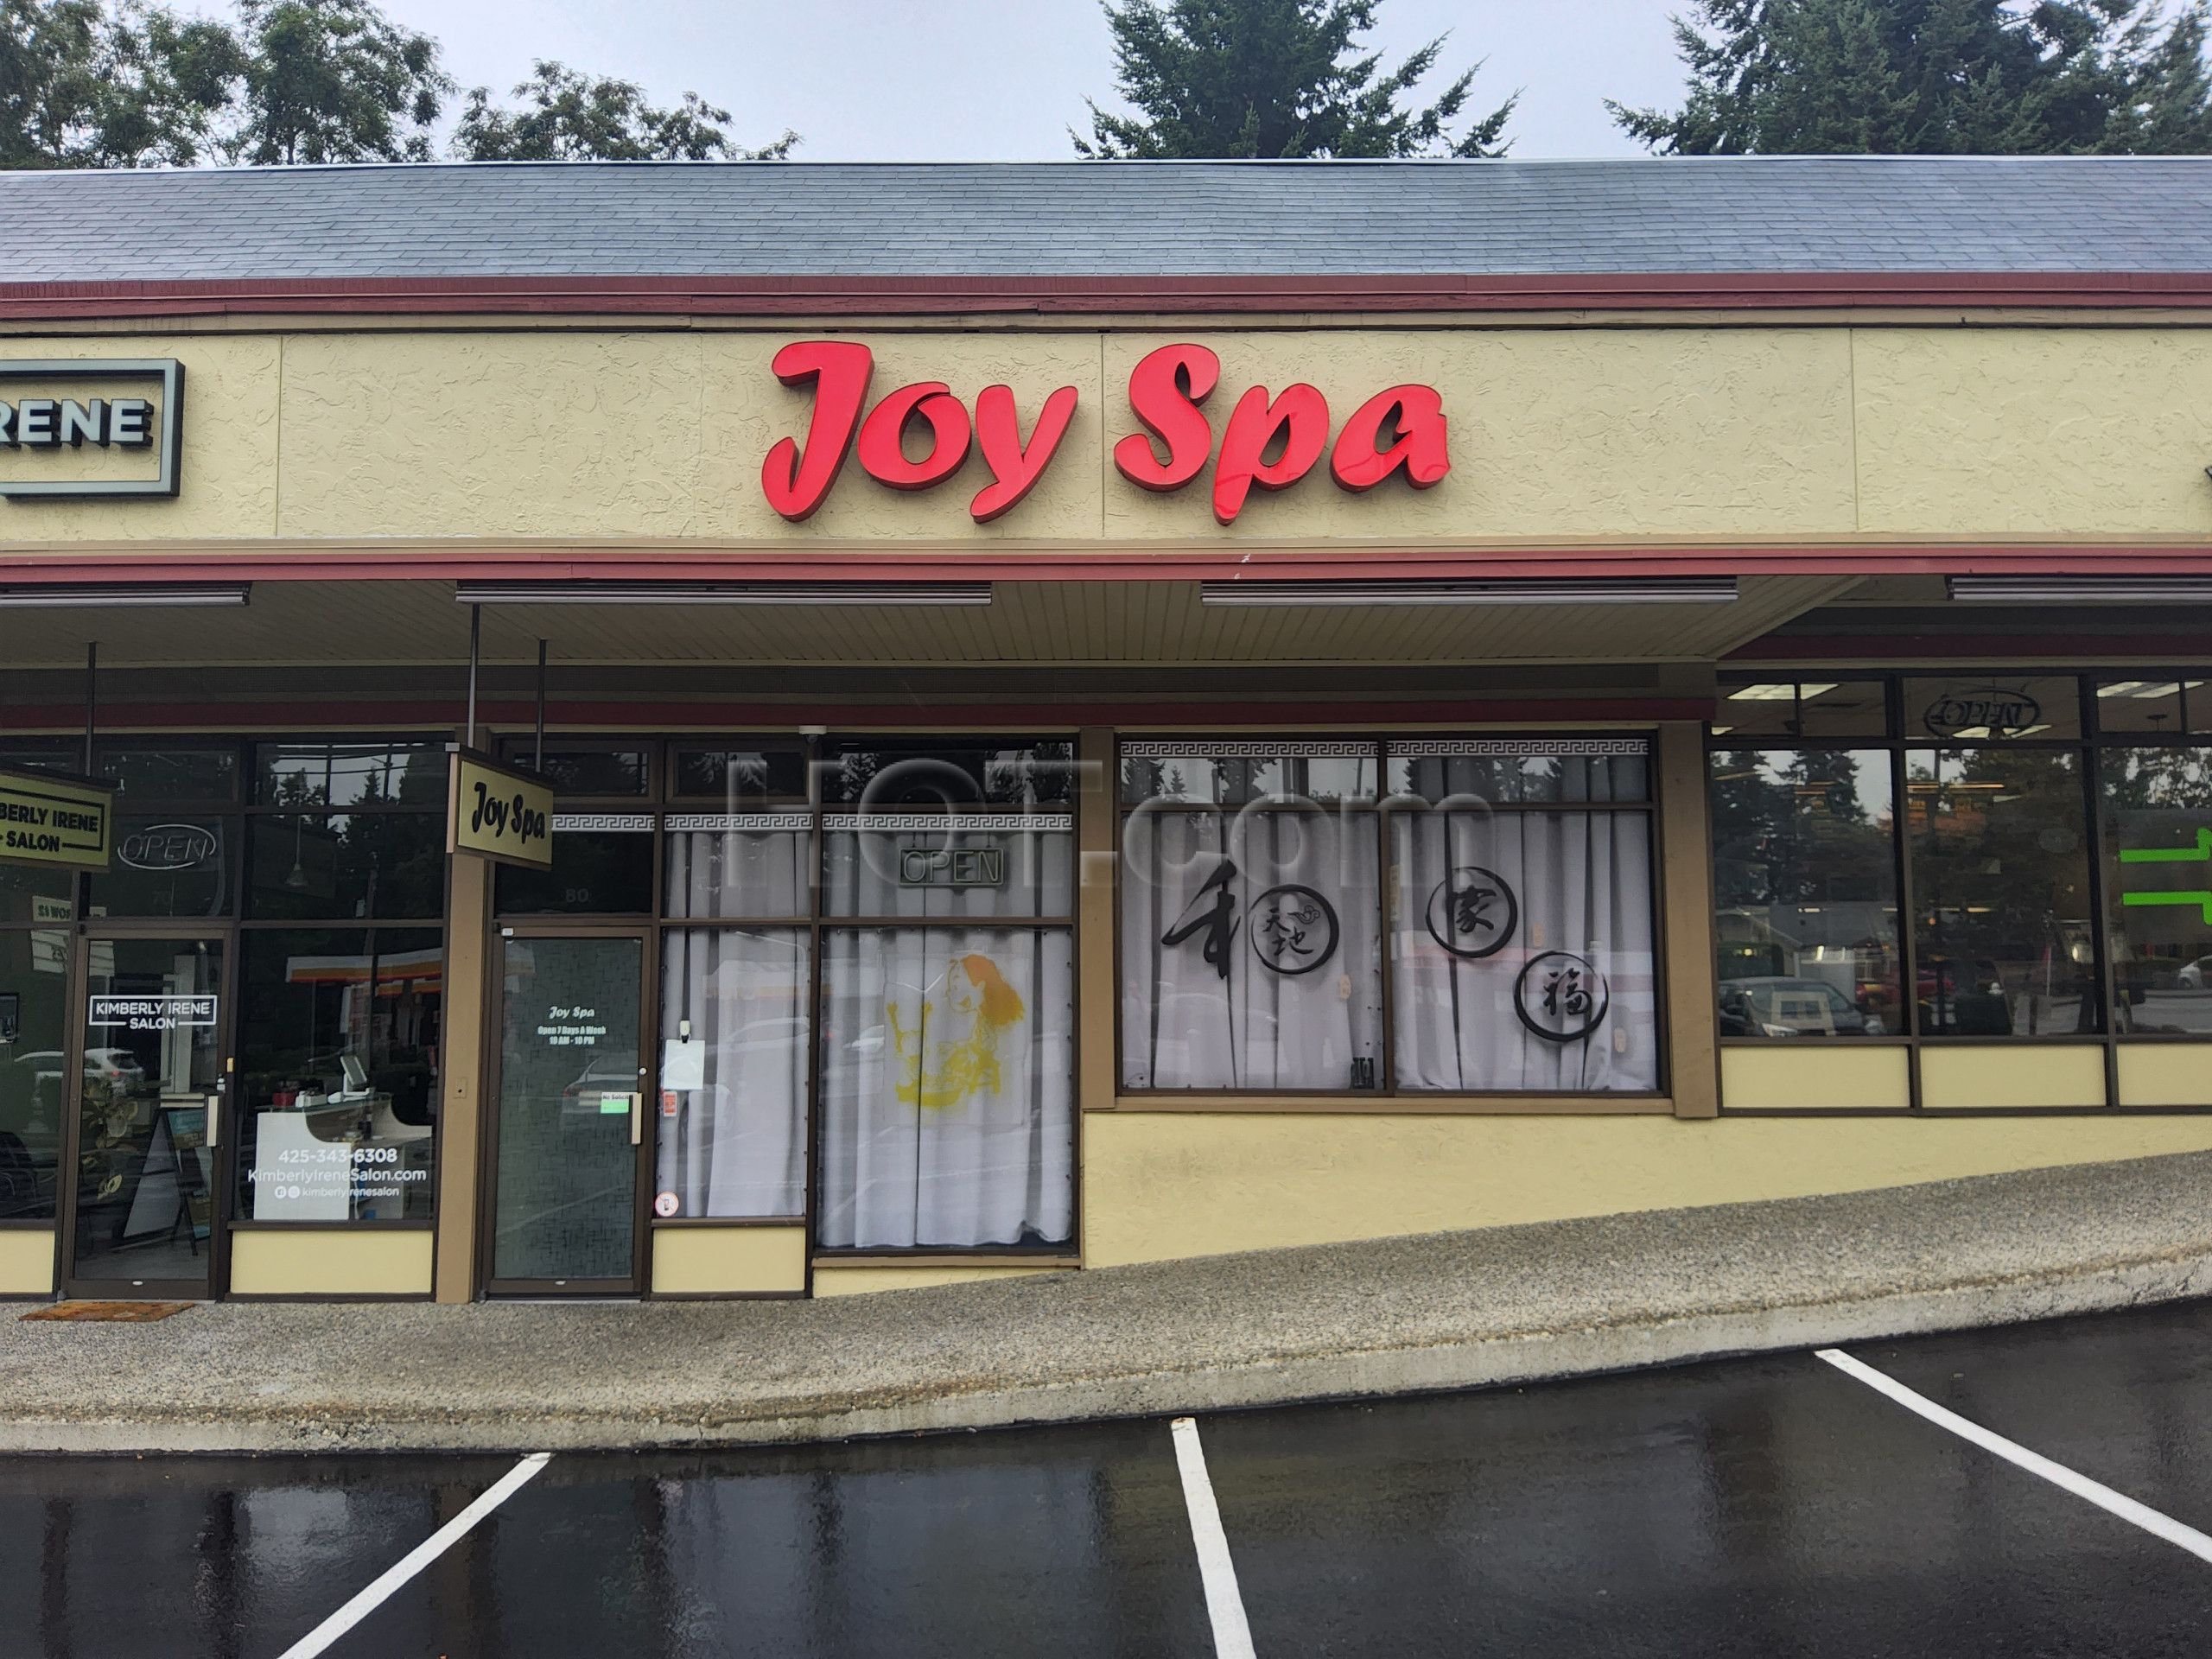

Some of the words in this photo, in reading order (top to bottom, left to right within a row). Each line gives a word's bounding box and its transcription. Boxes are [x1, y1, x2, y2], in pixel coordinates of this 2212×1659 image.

[761, 340, 1078, 523] Joy
[1114, 343, 1451, 524] Spa
[53, 810, 99, 832] IRENE
[472, 781, 509, 837] Joy
[512, 794, 545, 844] Spa
[6, 830, 60, 853] SALON
[124, 835, 207, 861] OPEN
[904, 851, 998, 881] OPEN
[566, 888, 589, 903] 80
[1543, 967, 1592, 1016] 福
[96, 1002, 164, 1015] KIMBERLY
[168, 1002, 210, 1015] IRENE
[549, 1006, 570, 1020] Joy
[572, 1006, 595, 1020] Spa
[130, 1018, 175, 1029] SALON
[537, 1026, 556, 1035] Open
[557, 1026, 562, 1034] 7
[562, 1026, 579, 1035] Days
[586, 1026, 606, 1035] Week
[558, 1036, 570, 1045] AM
[583, 1036, 595, 1045] PM
[278, 1147, 397, 1164] 425-343-6308
[247, 1166, 427, 1184] KimberlyIreneSalon.com
